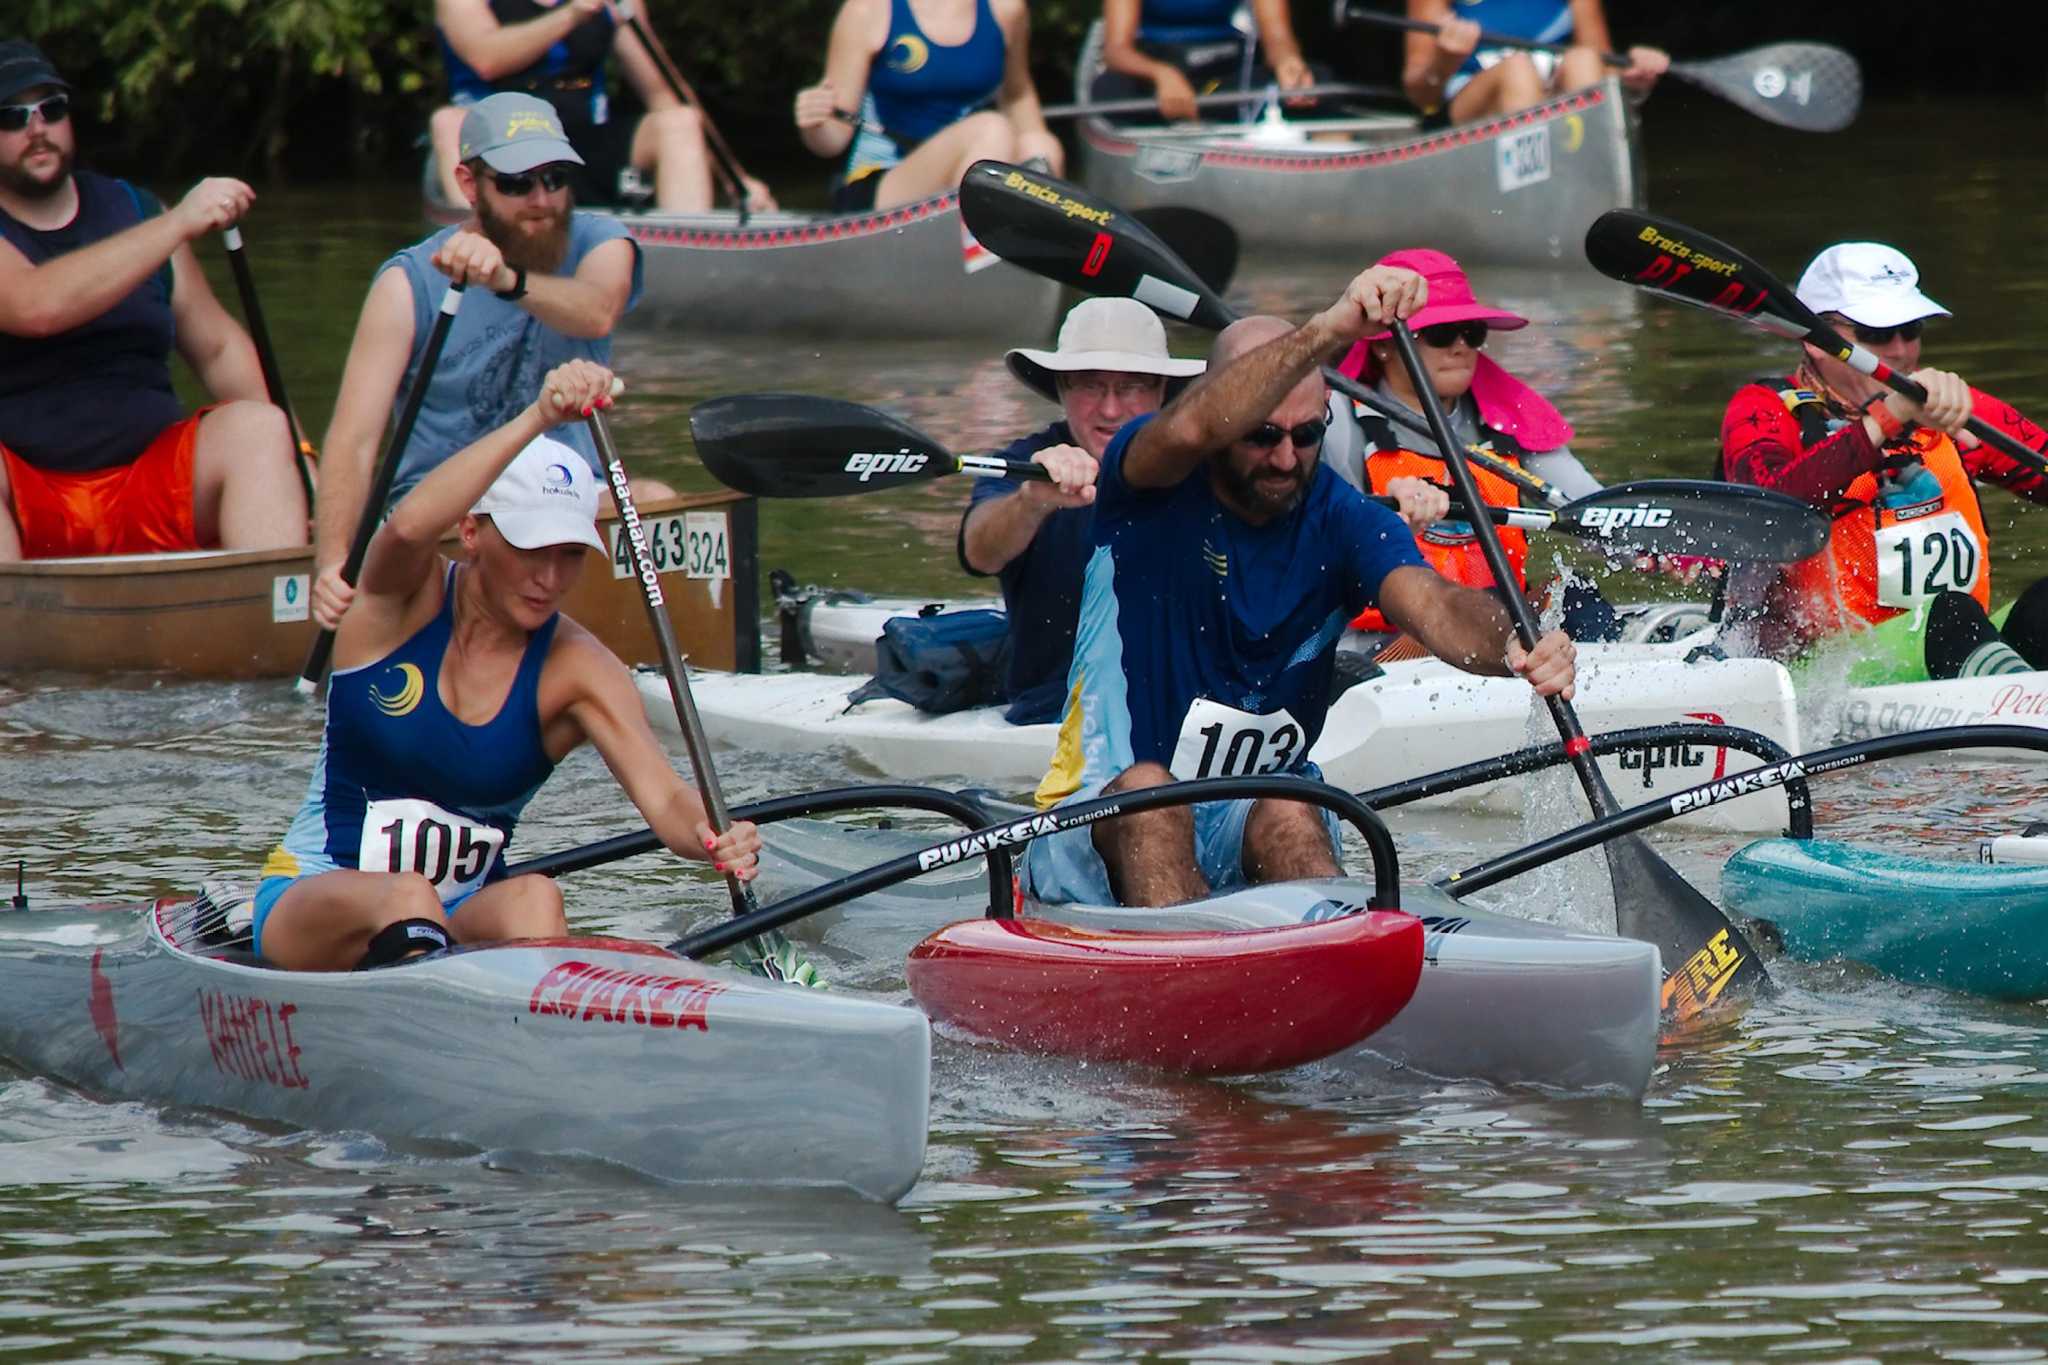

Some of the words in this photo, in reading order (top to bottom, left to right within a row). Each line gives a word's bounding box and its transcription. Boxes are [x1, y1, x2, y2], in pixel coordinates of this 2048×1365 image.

[844, 448, 929, 482] epic
[608, 459, 664, 608] vaa-max.com
[1579, 503, 1673, 537] epic
[689, 531, 727, 575] 324
[1893, 527, 1975, 596] 120
[1196, 721, 1299, 779] 103
[1670, 761, 1808, 815] PUAKEA
[1817, 754, 1866, 773] DESIGNS
[381, 818, 491, 886] 105
[917, 814, 1060, 871] PUAKEA
[1069, 804, 1121, 827] DESIGNS
